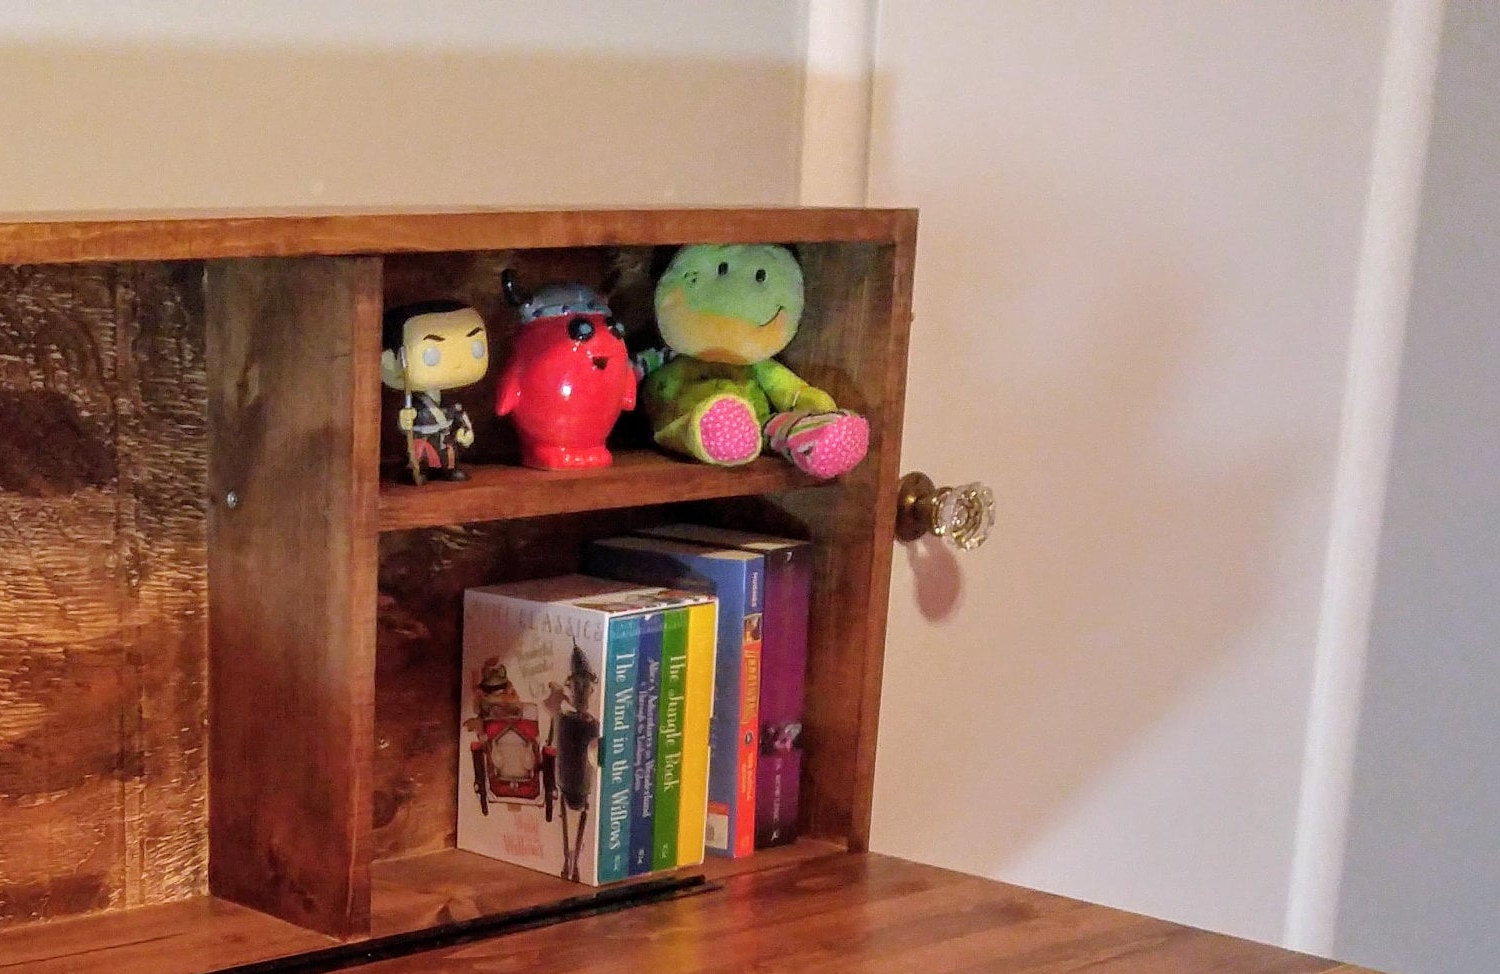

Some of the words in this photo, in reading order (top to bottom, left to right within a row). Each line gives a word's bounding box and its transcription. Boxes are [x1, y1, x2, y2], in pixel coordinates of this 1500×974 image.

[615, 648, 635, 682] The
[669, 655, 686, 681] The
[613, 686, 633, 731] Wind
[660, 688, 684, 747] Jungle
[612, 737, 628, 754] in
[611, 759, 629, 784] the
[663, 751, 681, 792] Book
[608, 788, 629, 851] Willows
